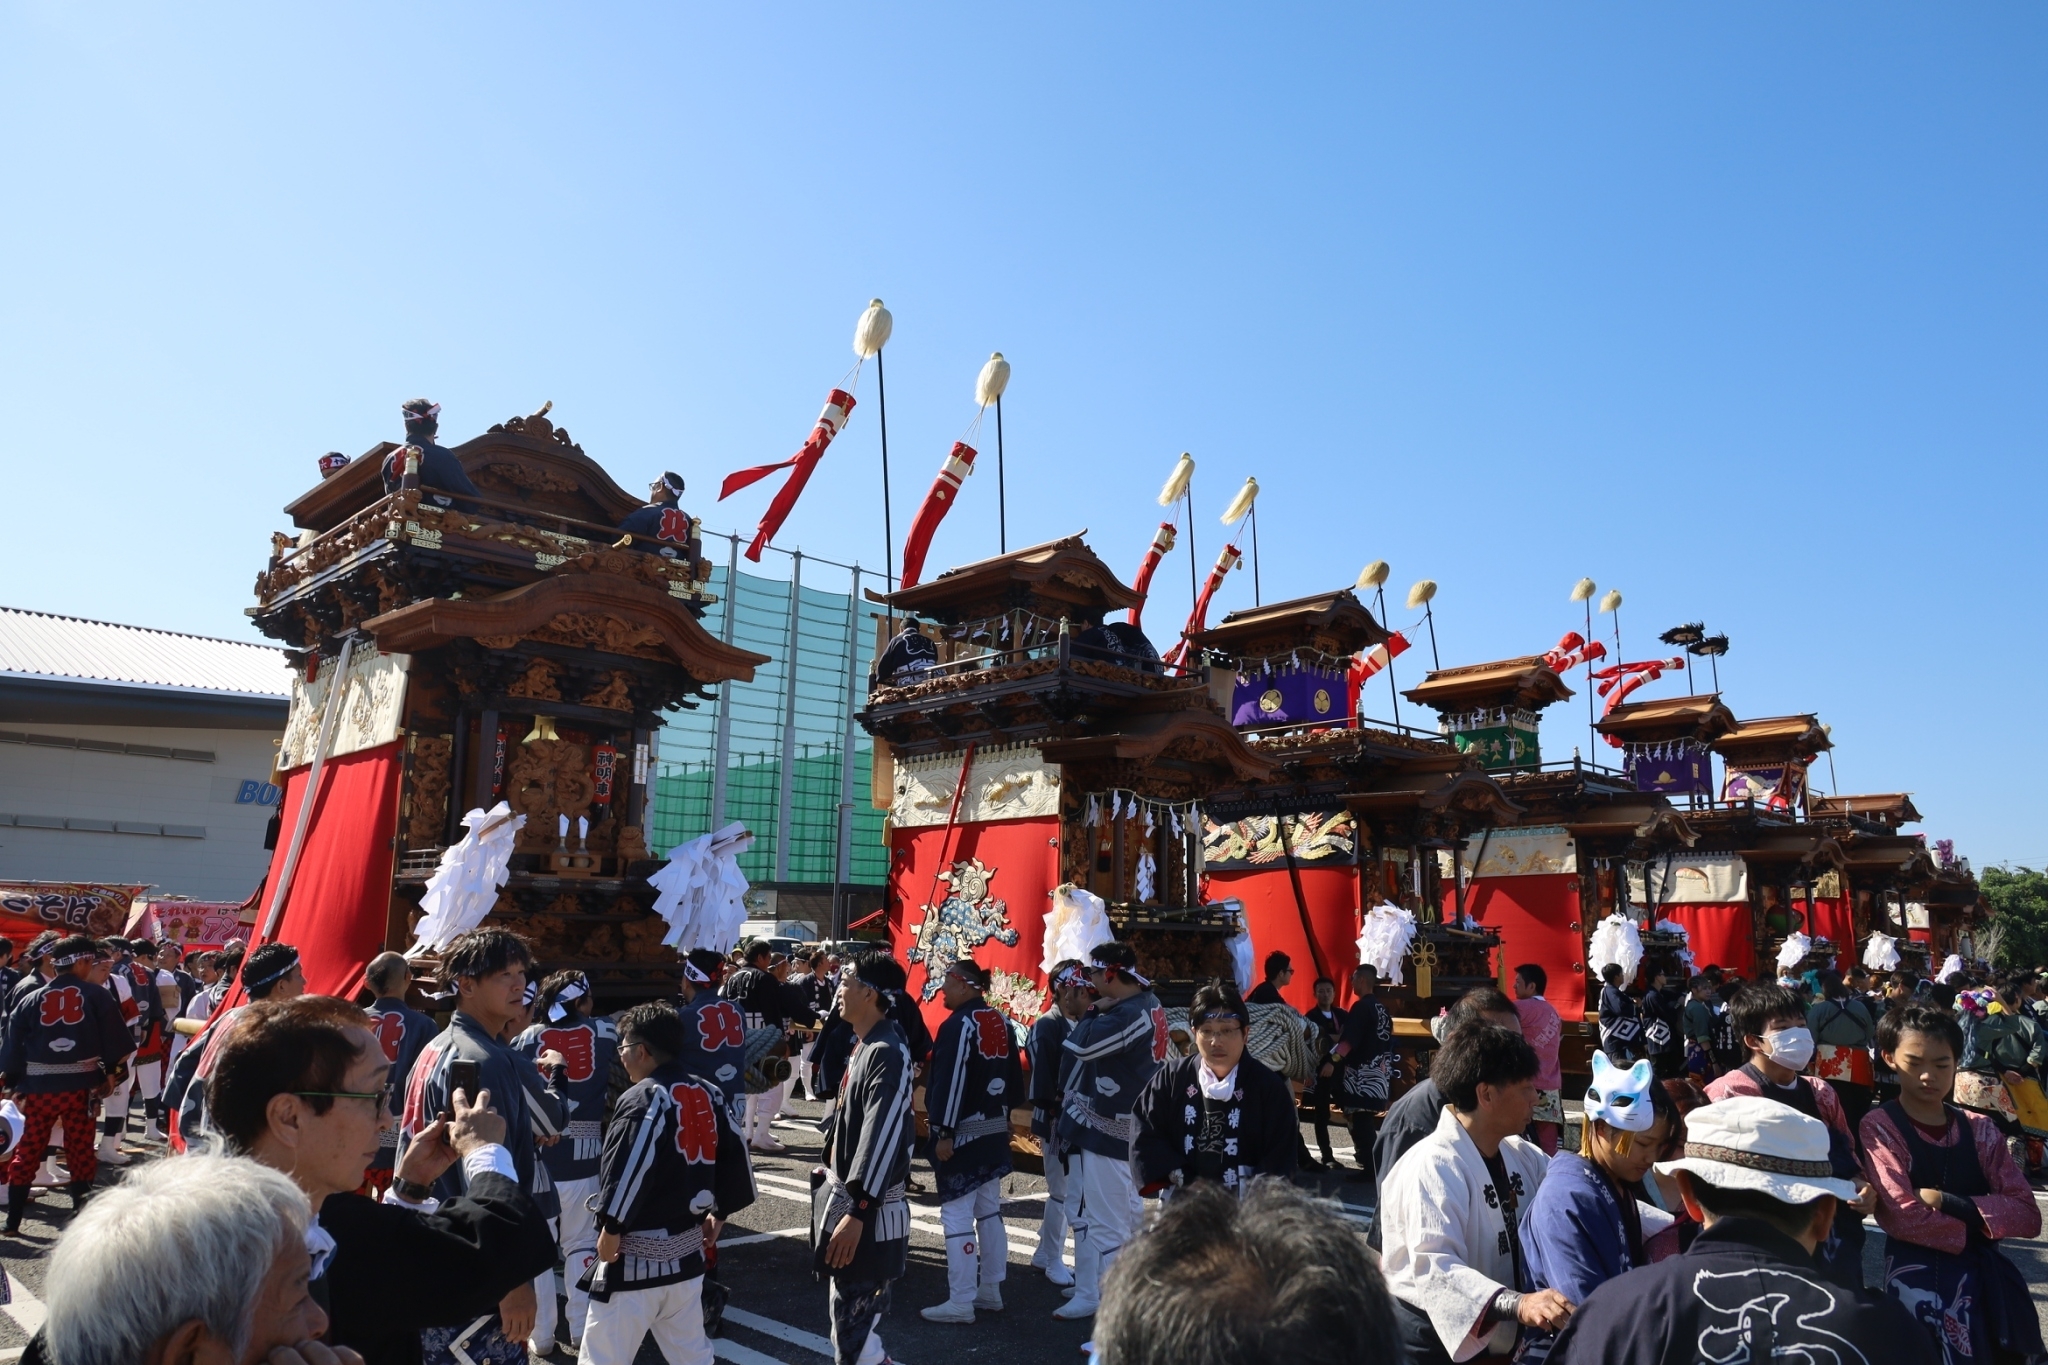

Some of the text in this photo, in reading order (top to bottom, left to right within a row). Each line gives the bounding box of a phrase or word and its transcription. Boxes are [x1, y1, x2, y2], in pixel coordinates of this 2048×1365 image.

[237, 779, 282, 807] BO
[596, 752, 614, 796] 神明車
[1223, 1107, 1240, 1189] 常石車
